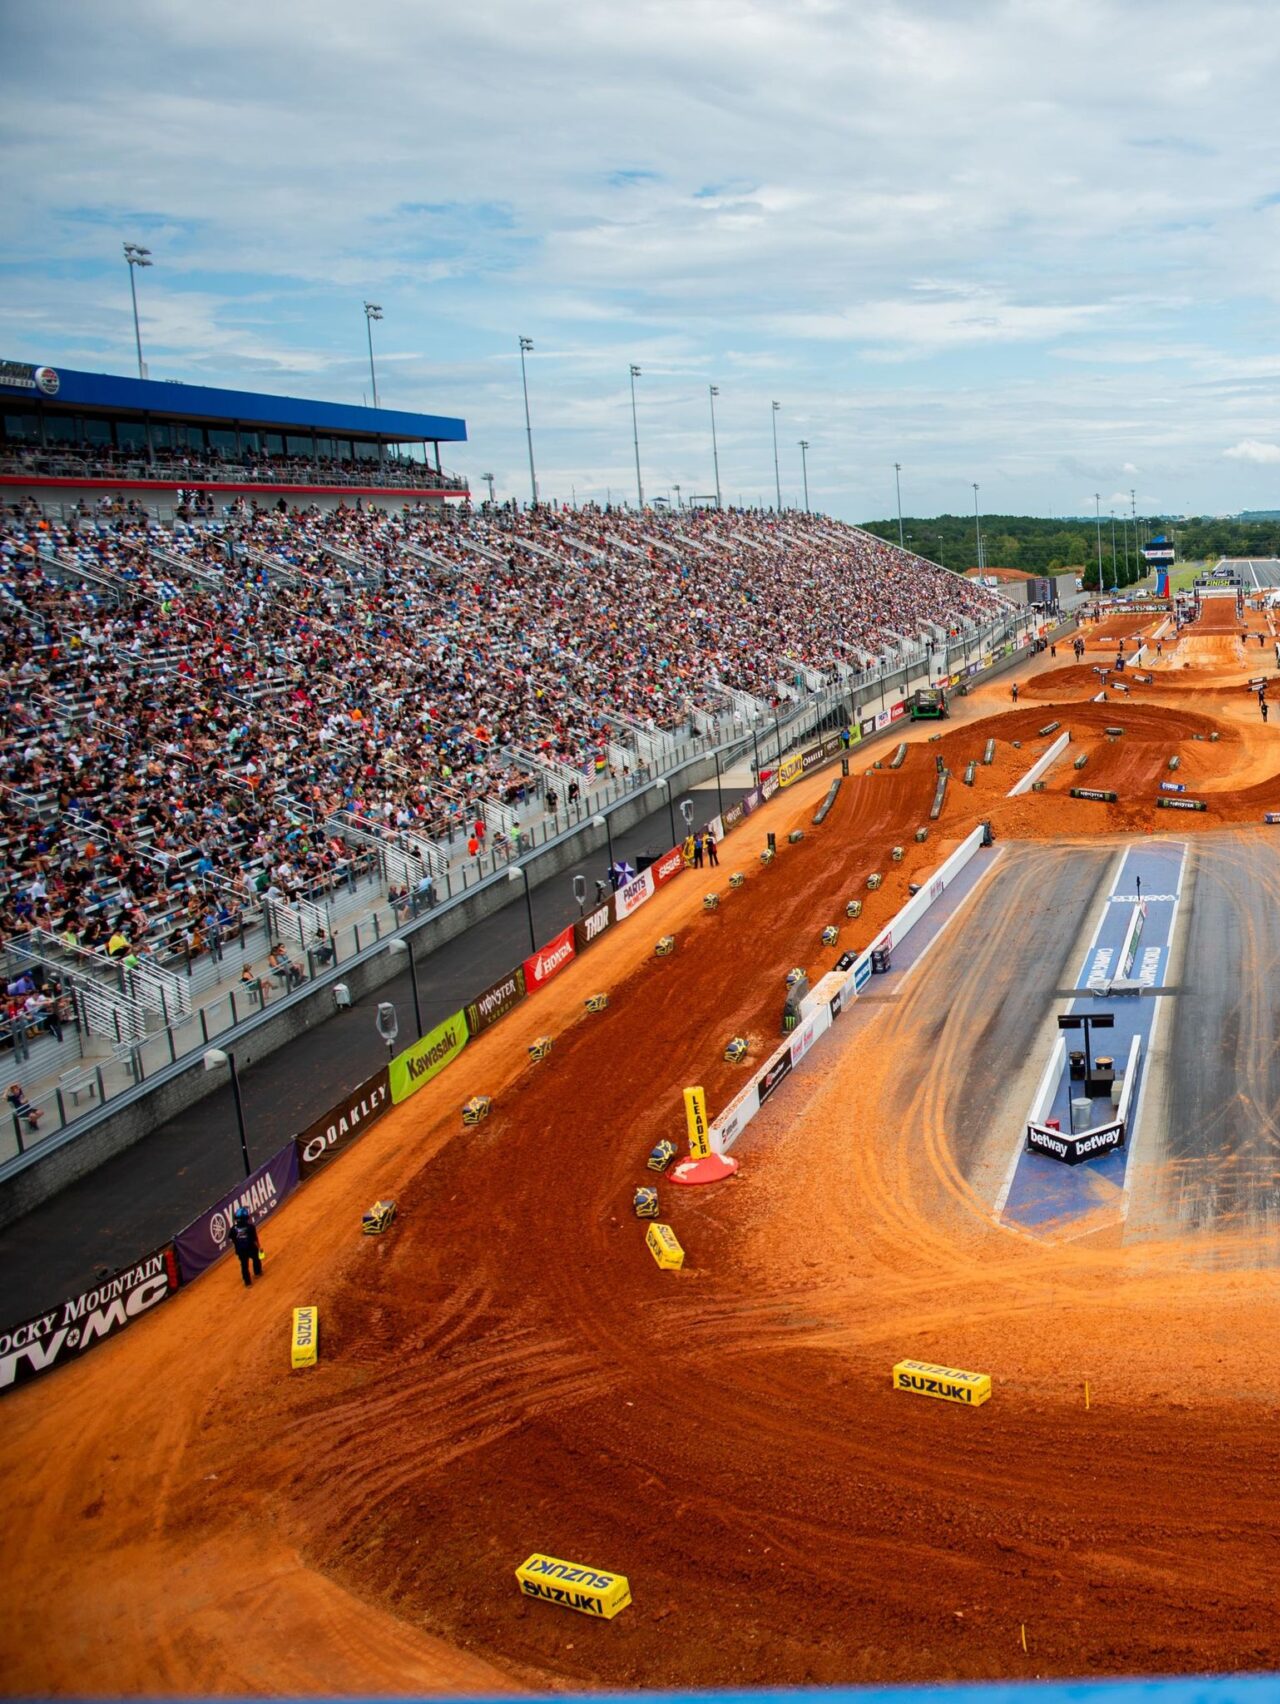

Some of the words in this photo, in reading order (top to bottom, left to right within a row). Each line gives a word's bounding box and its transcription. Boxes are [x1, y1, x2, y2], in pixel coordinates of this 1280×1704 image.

[1205, 579, 1230, 587] FINISH
[623, 874, 646, 902] PARTS
[584, 905, 609, 941] THOR
[543, 940, 573, 975] HONDA
[478, 978, 517, 1017] MONSTER
[406, 1026, 458, 1083] Kawasaki
[326, 1083, 388, 1145] OAKLEY
[692, 1094, 708, 1155] LEADER
[1030, 1128, 1069, 1158] betway
[1075, 1127, 1121, 1156] betway
[0, 1312, 58, 1356] OCKY
[61, 1253, 165, 1327] MOUNTAIN
[297, 1308, 313, 1346] SUZUKI
[898, 1373, 972, 1403] SUZUKI
[903, 1361, 981, 1382] SUZUKI
[525, 1559, 614, 1589] SUZUKI
[522, 1579, 603, 1614] SUZUKI
